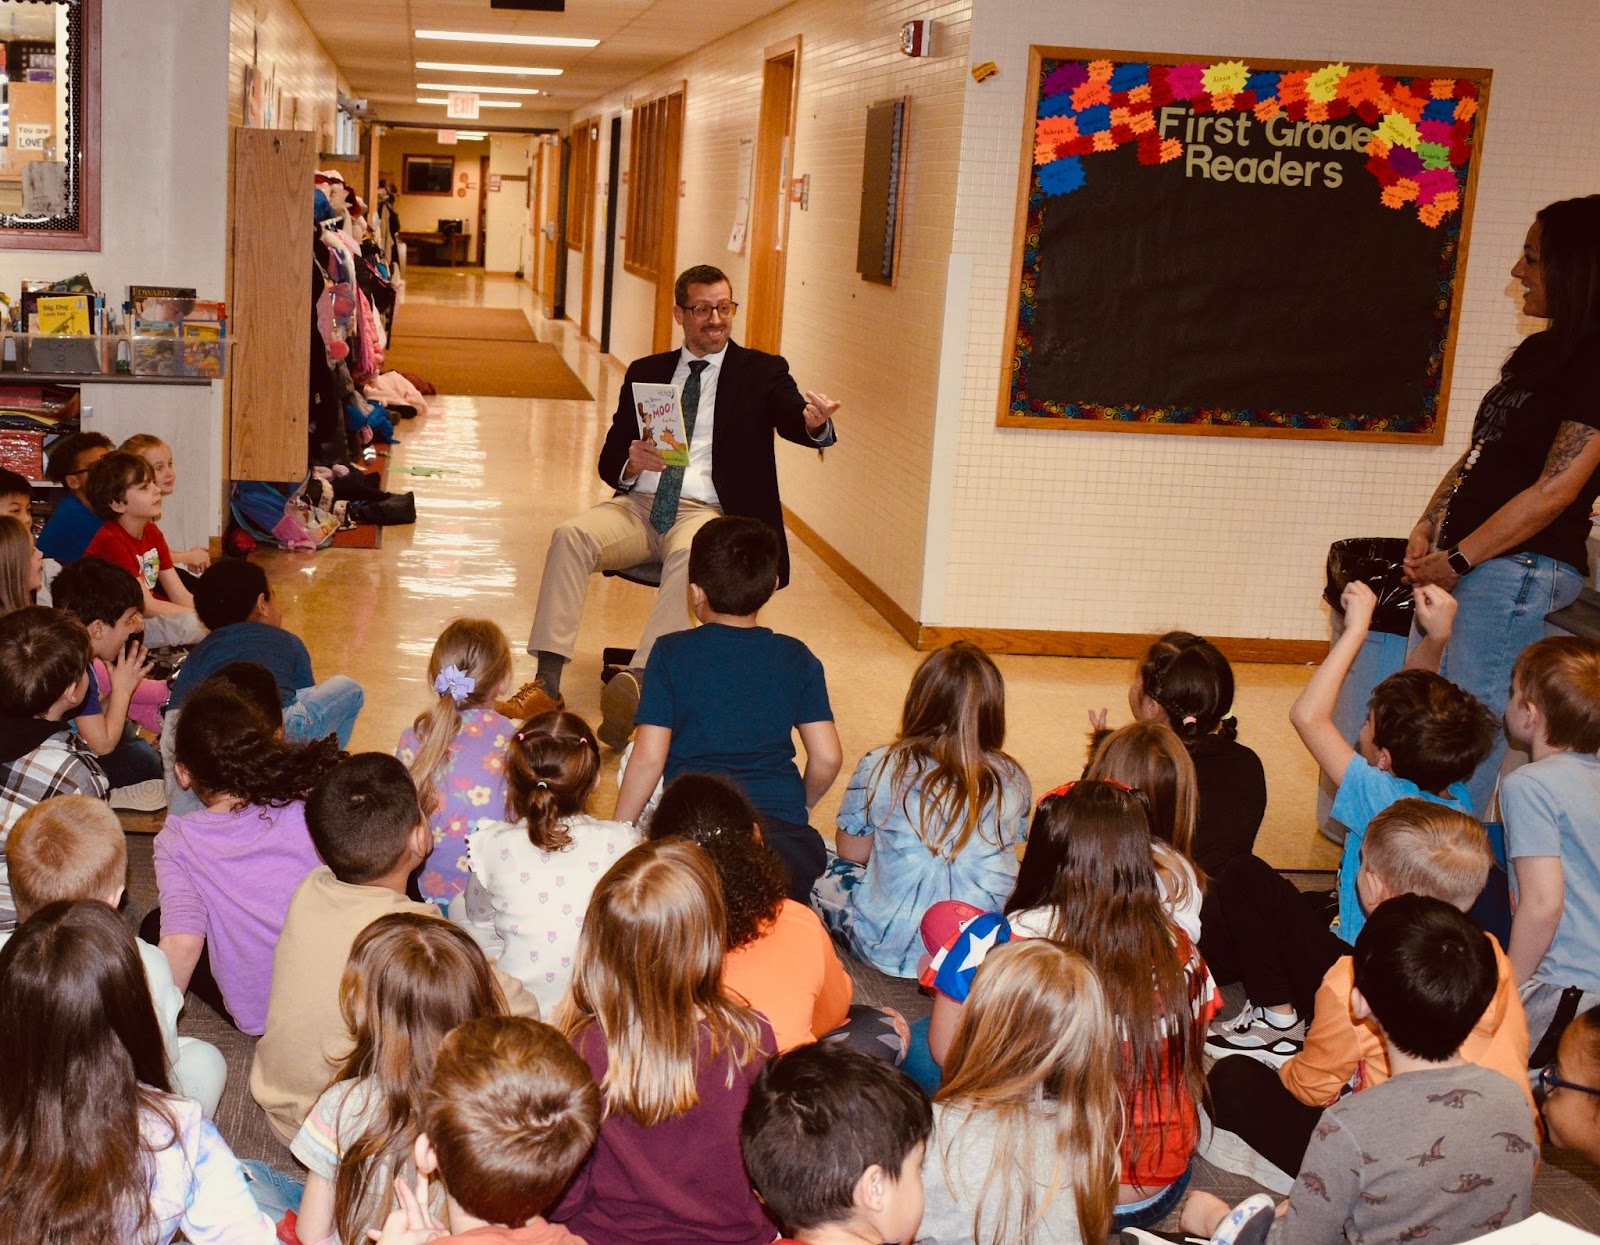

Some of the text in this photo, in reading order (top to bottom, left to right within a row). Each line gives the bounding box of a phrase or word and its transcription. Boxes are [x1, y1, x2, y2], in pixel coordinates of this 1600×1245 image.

[453, 96, 476, 114] EXIT
[18, 126, 49, 135] You are
[1159, 106, 1252, 147] First
[1265, 111, 1374, 154] Grade
[19, 137, 43, 148] LOVE
[1186, 144, 1344, 189] Readers
[653, 402, 675, 419] MOO!
